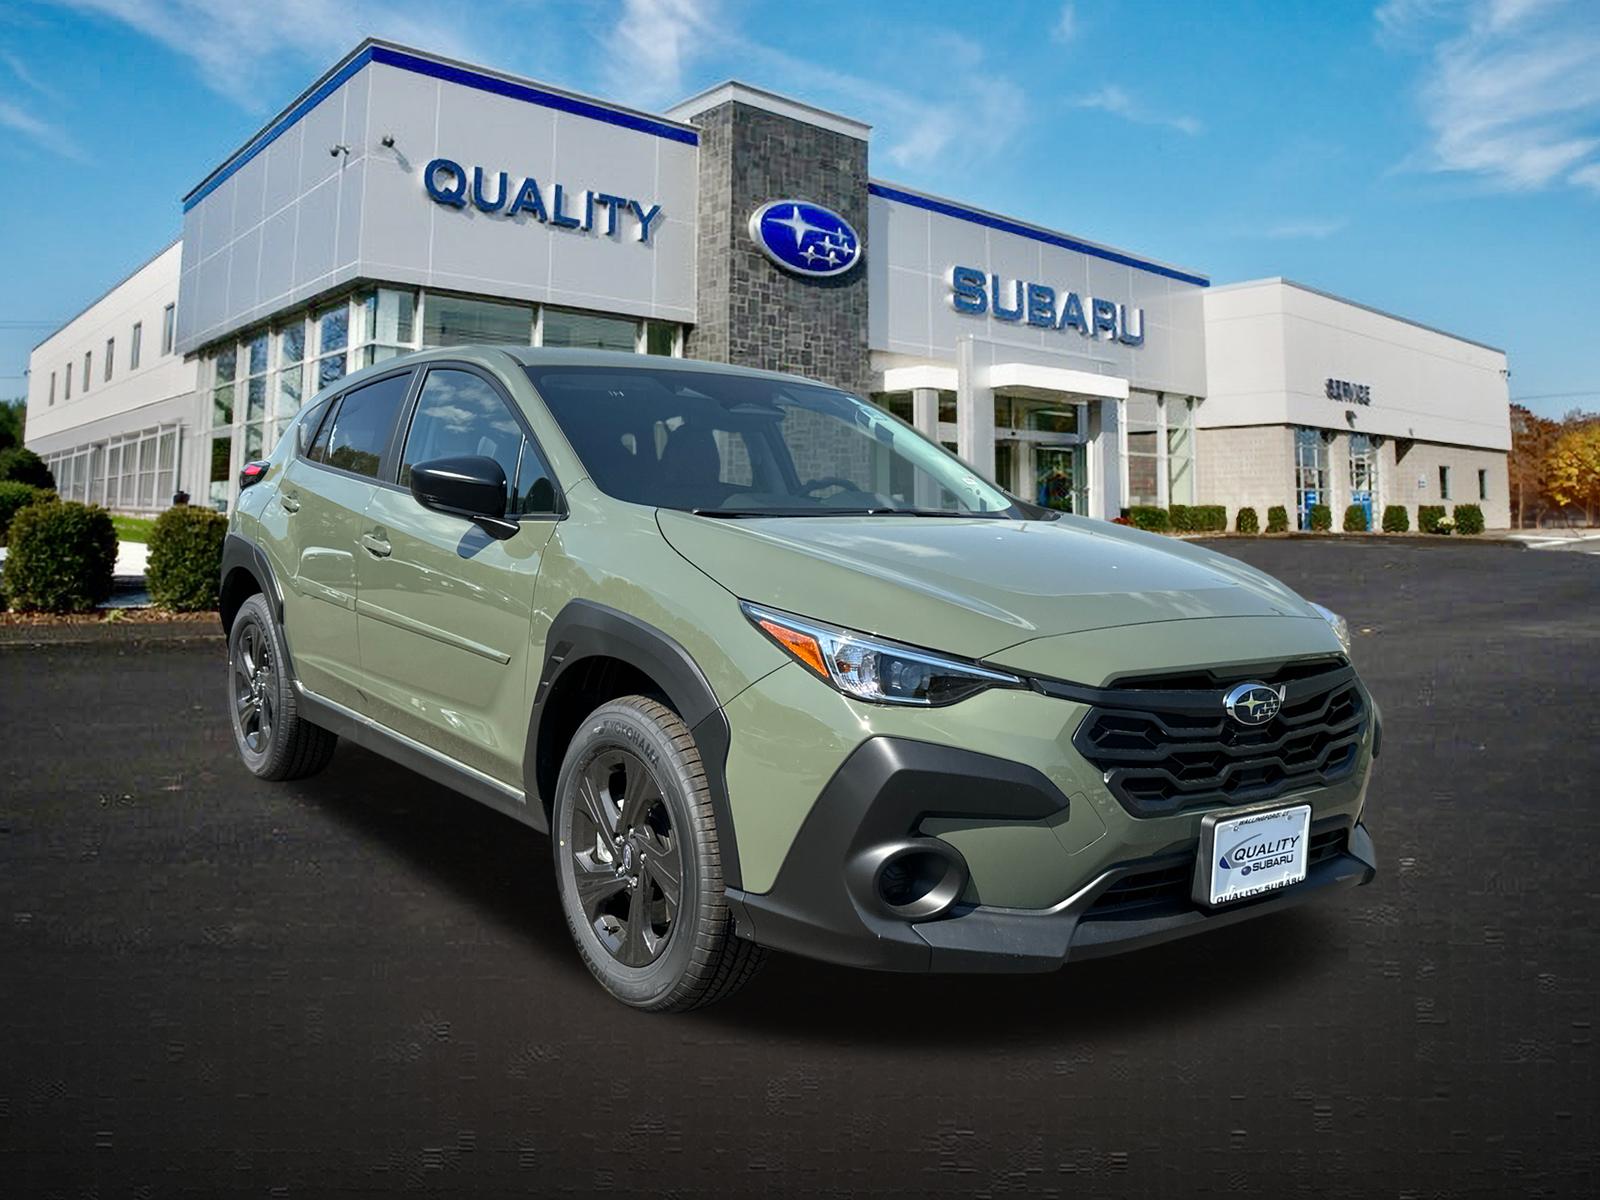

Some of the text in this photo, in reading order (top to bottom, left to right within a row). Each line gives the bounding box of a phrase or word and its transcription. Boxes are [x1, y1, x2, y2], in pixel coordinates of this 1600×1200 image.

[424, 158, 661, 243] QUALITY
[951, 265, 1145, 346] SUBARU
[604, 721, 660, 769] YOKOHAMA
[1234, 835, 1300, 861] QUALITY
[1252, 854, 1294, 872] SUBARU
[1216, 875, 1305, 904] QUALITY SUBARU
